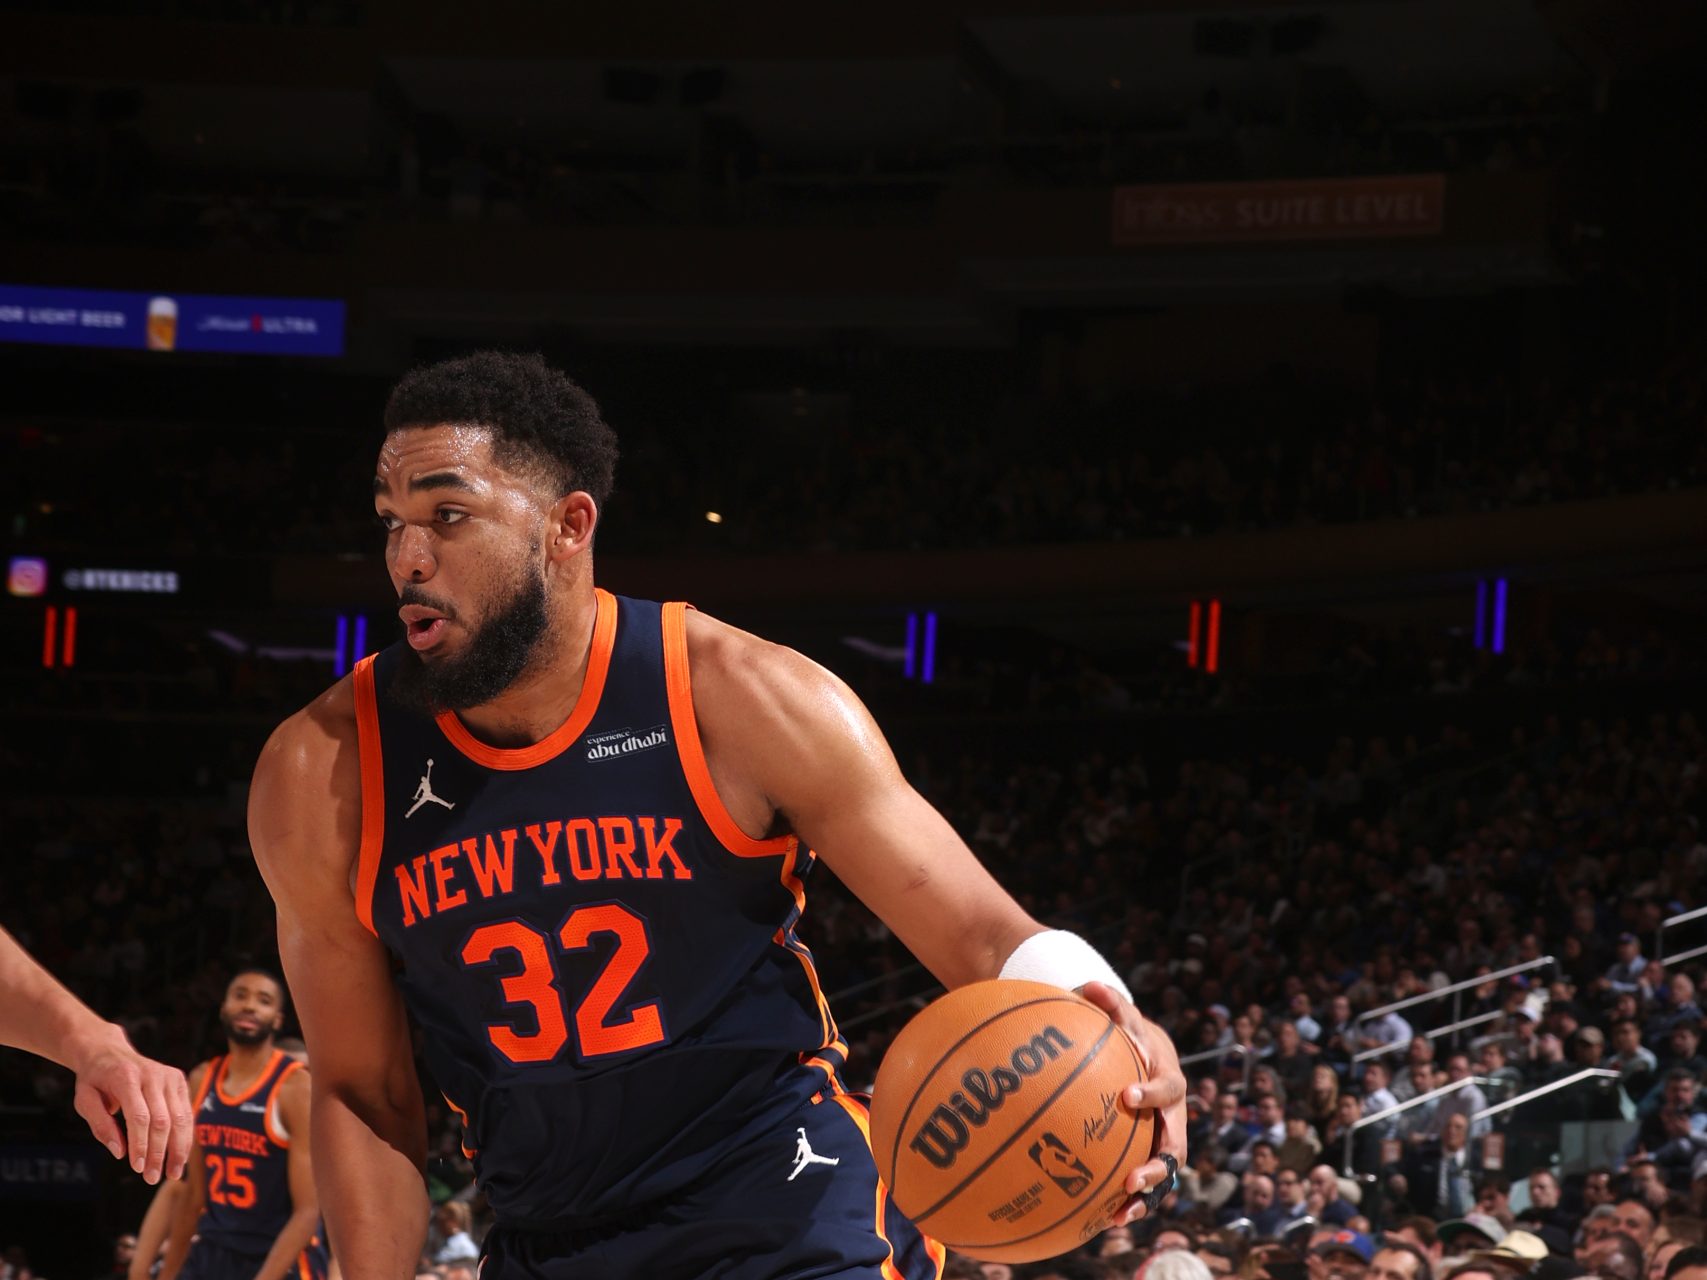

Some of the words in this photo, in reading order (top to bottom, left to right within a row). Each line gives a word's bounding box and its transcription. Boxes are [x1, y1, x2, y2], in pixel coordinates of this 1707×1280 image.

[1236, 197, 1324, 227] SUITE
[1336, 192, 1431, 224] LEVEL
[28, 307, 77, 325] LIGHT
[80, 310, 126, 329] BEER
[587, 743, 620, 760] abu
[621, 727, 667, 752] dhabi
[394, 829, 518, 928] NEW
[526, 816, 692, 886] YORK
[460, 903, 666, 1064] 32
[909, 1025, 1074, 1170] Wilson
[221, 1125, 270, 1157] YORK
[205, 1154, 257, 1209] 25
